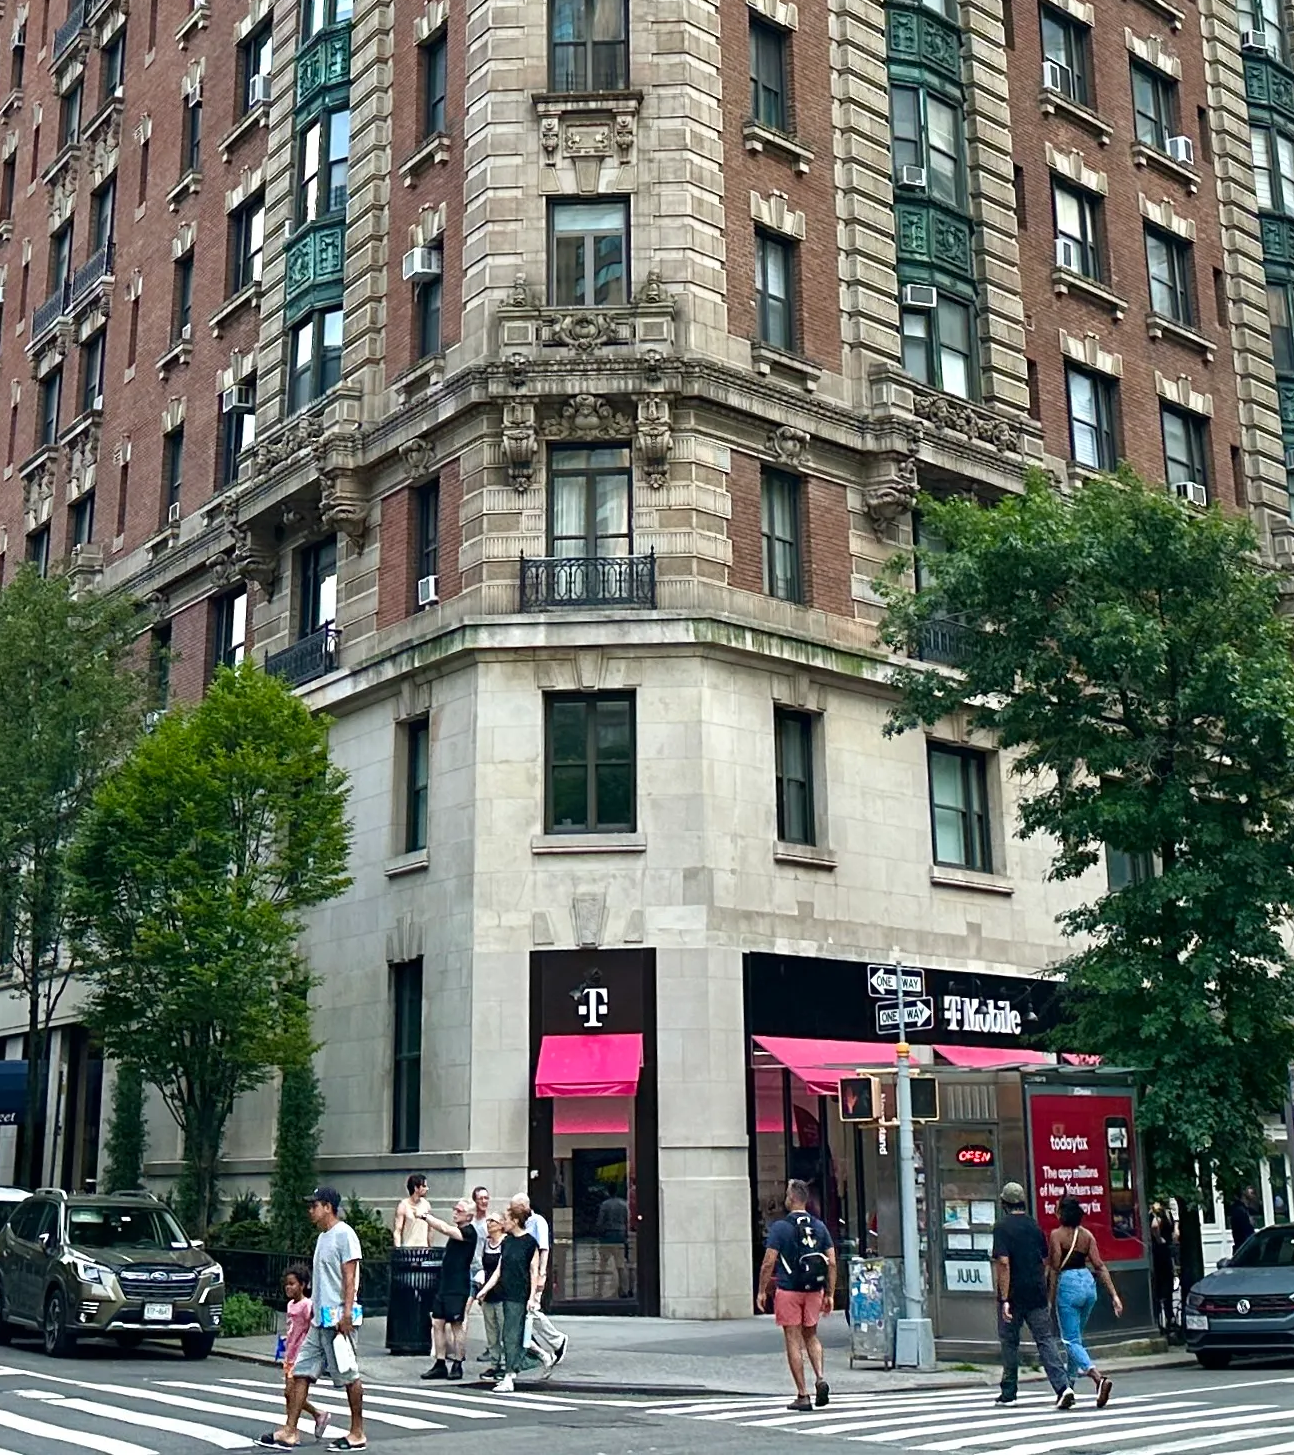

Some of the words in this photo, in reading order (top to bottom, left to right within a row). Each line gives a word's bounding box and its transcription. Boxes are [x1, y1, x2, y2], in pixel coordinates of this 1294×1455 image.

[876, 975, 893, 988] ONE
[901, 977, 919, 990] WAY
[881, 1010, 898, 1023] ONE
[907, 1008, 925, 1021] WAY
[958, 1149, 991, 1163] OPEN
[1042, 1165, 1057, 1179] The
[1058, 1168, 1072, 1181] app
[1073, 1165, 1099, 1178] millions
[1039, 1182, 1048, 1196] of
[1048, 1182, 1065, 1196] New
[1065, 1182, 1091, 1196] Yorkers
[1091, 1185, 1104, 1195] use
[1044, 1200, 1056, 1214] for
[956, 1267, 984, 1285] JUUL
